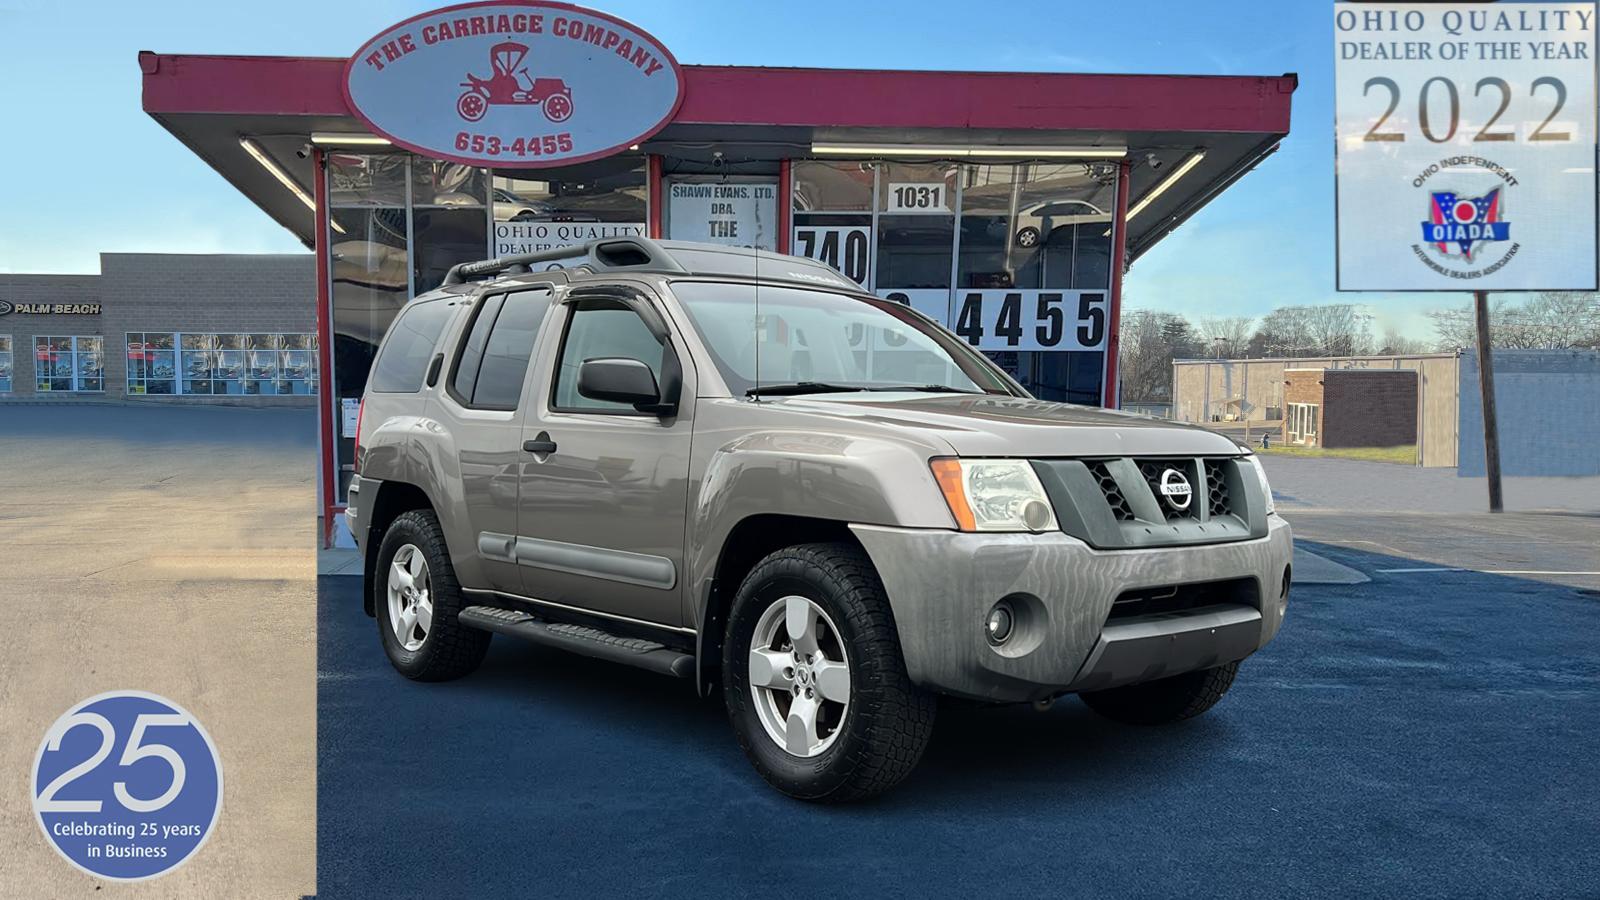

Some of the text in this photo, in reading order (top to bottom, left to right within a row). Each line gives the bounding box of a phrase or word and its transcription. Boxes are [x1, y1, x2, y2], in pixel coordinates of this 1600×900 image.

[1336, 10, 1593, 35] OHIO QUALITY
[365, 14, 664, 77] THE CARRIAGE COMPANY
[1340, 42, 1589, 60] DEALER OF THE YEAR
[1363, 76, 1571, 143] 2022
[455, 132, 573, 157] 653-4455
[1412, 156, 1519, 188] OHIO INDEPENDENT
[672, 186, 711, 198] SHAWN
[754, 187, 775, 199] LTD.
[894, 186, 940, 209] 1031
[711, 203, 736, 215] DBA.
[497, 226, 644, 240] OHIO QUALITY
[708, 220, 738, 238] THE
[1432, 225, 1495, 241] OIADA
[797, 230, 869, 285] 740
[1411, 242, 1521, 280] AUTOMOBILE DEALERS ASSOCIATION
[14, 303, 100, 314] PALM BEACH
[956, 292, 1105, 347] 4455
[1166, 485, 1192, 494] NISSAN
